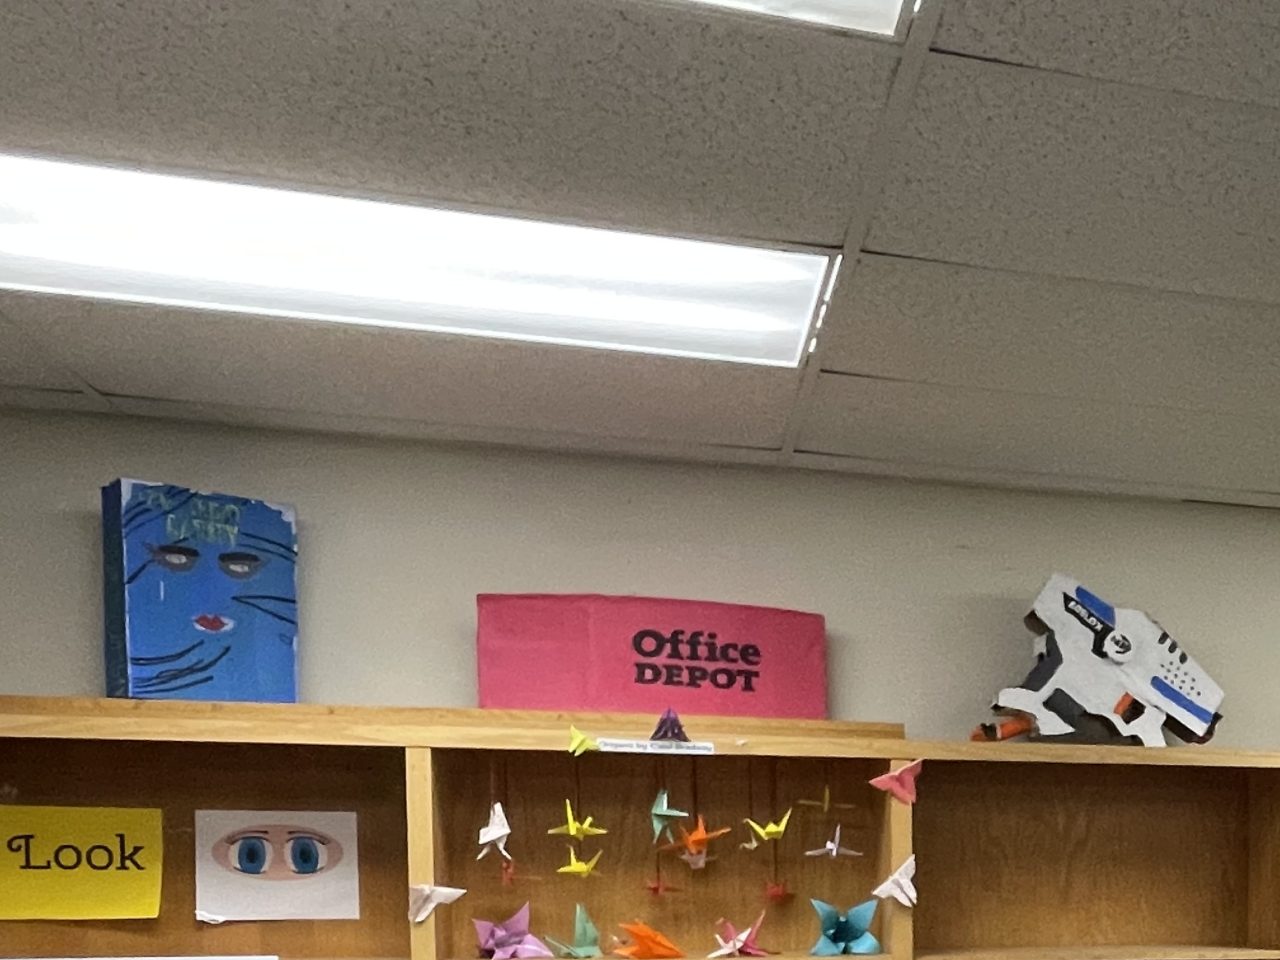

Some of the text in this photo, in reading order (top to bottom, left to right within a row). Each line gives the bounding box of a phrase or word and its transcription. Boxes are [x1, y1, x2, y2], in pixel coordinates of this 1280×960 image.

[632, 628, 762, 666] Office
[634, 662, 760, 693] DEPOT
[6, 833, 145, 871] Look
